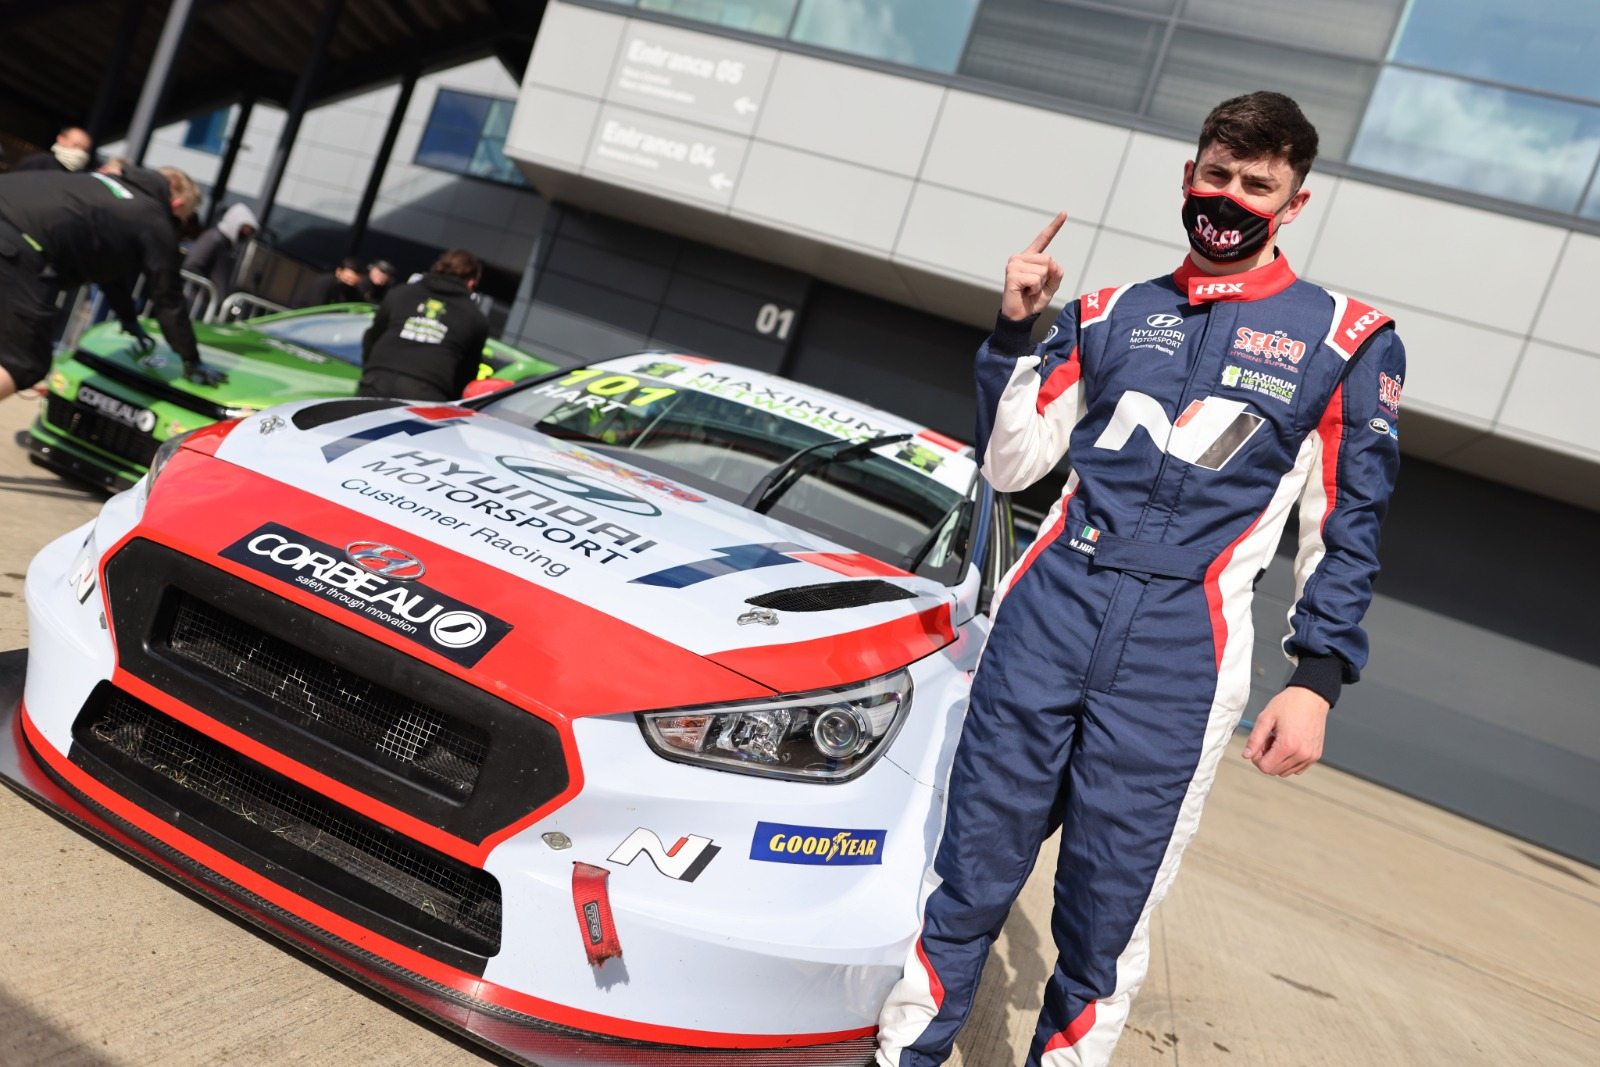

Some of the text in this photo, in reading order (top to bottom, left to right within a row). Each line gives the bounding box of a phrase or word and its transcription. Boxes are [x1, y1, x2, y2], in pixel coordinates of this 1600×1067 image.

[627, 39, 715, 79] Entrance
[602, 120, 688, 161] Entrance
[1195, 214, 1242, 247] SELCO
[1087, 291, 1099, 310] RX
[1195, 283, 1245, 295] HRX
[755, 303, 795, 340] 01
[1131, 328, 1185, 342] HYUNDAI
[1345, 310, 1385, 341] HRX
[1129, 336, 1182, 349] MOTORSPORT
[1155, 344, 1175, 356] Racing
[1235, 326, 1306, 362] SELCO
[532, 384, 628, 413] HART
[559, 369, 677, 407] 101
[1241, 377, 1294, 399] NETWORKS
[1243, 369, 1297, 393] MAXIMUM
[699, 371, 887, 438] MAXIMUM
[361, 460, 629, 565] MOTORSPORT
[391, 450, 658, 554] HYUNDAI
[340, 478, 571, 579] Customer Racing
[247, 533, 444, 623] CORBEAU
[295, 575, 418, 635] safety through innovation
